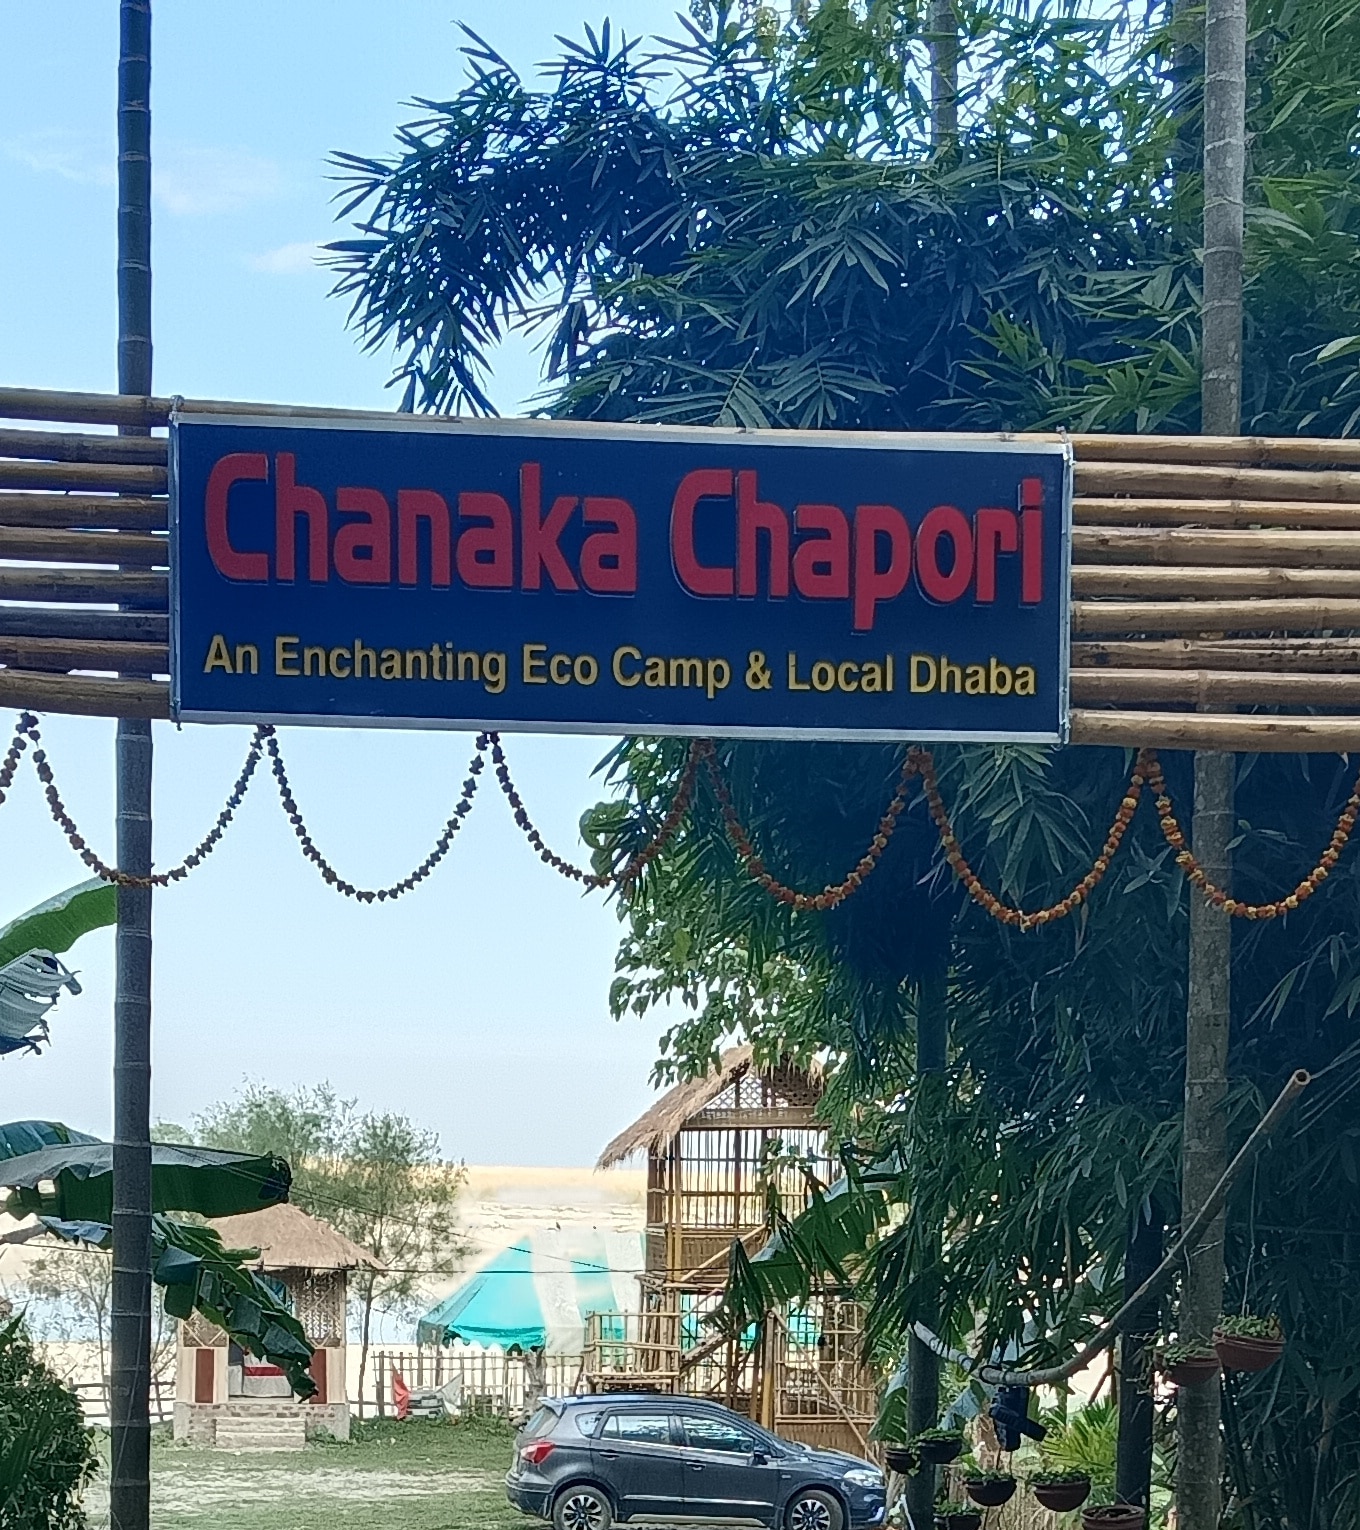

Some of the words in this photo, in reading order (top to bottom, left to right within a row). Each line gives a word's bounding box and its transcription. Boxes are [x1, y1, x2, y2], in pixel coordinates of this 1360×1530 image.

[204, 451, 637, 595] Chanaka
[671, 468, 1042, 632] Chapori
[204, 634, 259, 674] An
[274, 635, 508, 694] Enchanting
[521, 643, 600, 686] Eco
[611, 645, 731, 699] Camp
[744, 650, 773, 692] &
[786, 652, 895, 694] Local
[908, 654, 1037, 698] Dhaba
